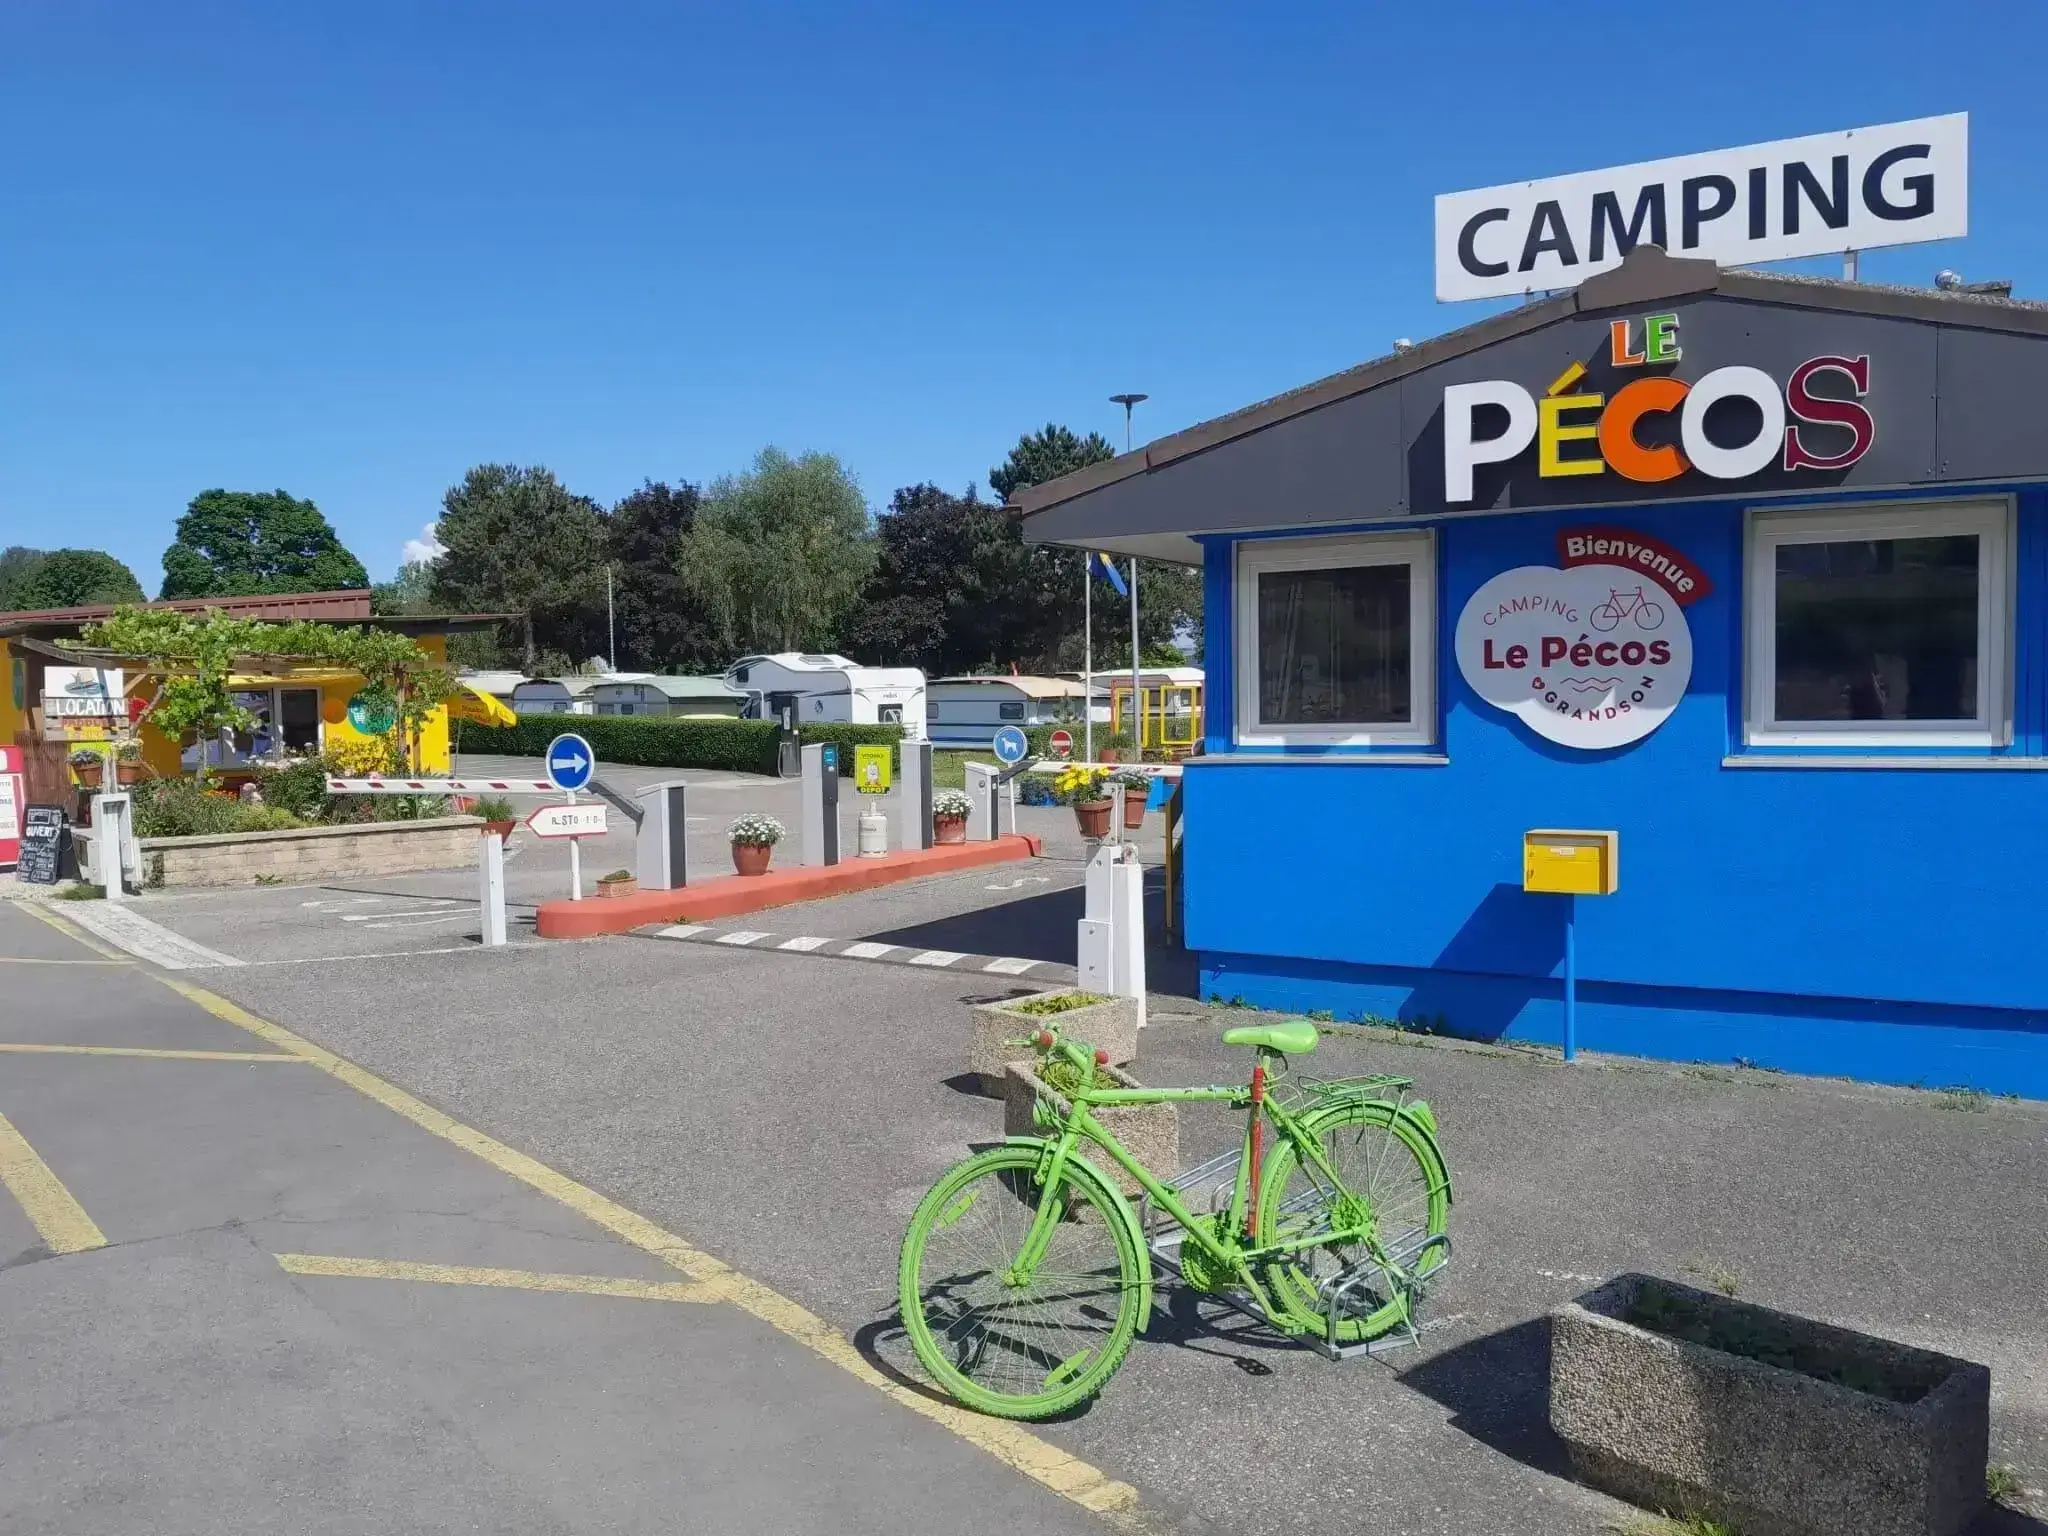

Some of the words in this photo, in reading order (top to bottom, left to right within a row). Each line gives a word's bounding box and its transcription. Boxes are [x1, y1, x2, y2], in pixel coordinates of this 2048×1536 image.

[1457, 144, 1936, 277] CAMPING
[1609, 313, 1683, 368] LE
[1444, 354, 1876, 503] PÉCOS
[1566, 534, 1695, 594] Bienvenue
[1483, 595, 1579, 626] CAMPING
[1483, 638, 1529, 669] Le
[1541, 633, 1671, 668] Pécos
[55, 698, 125, 716] LOCATION
[1544, 675, 1655, 722] GRANDSON
